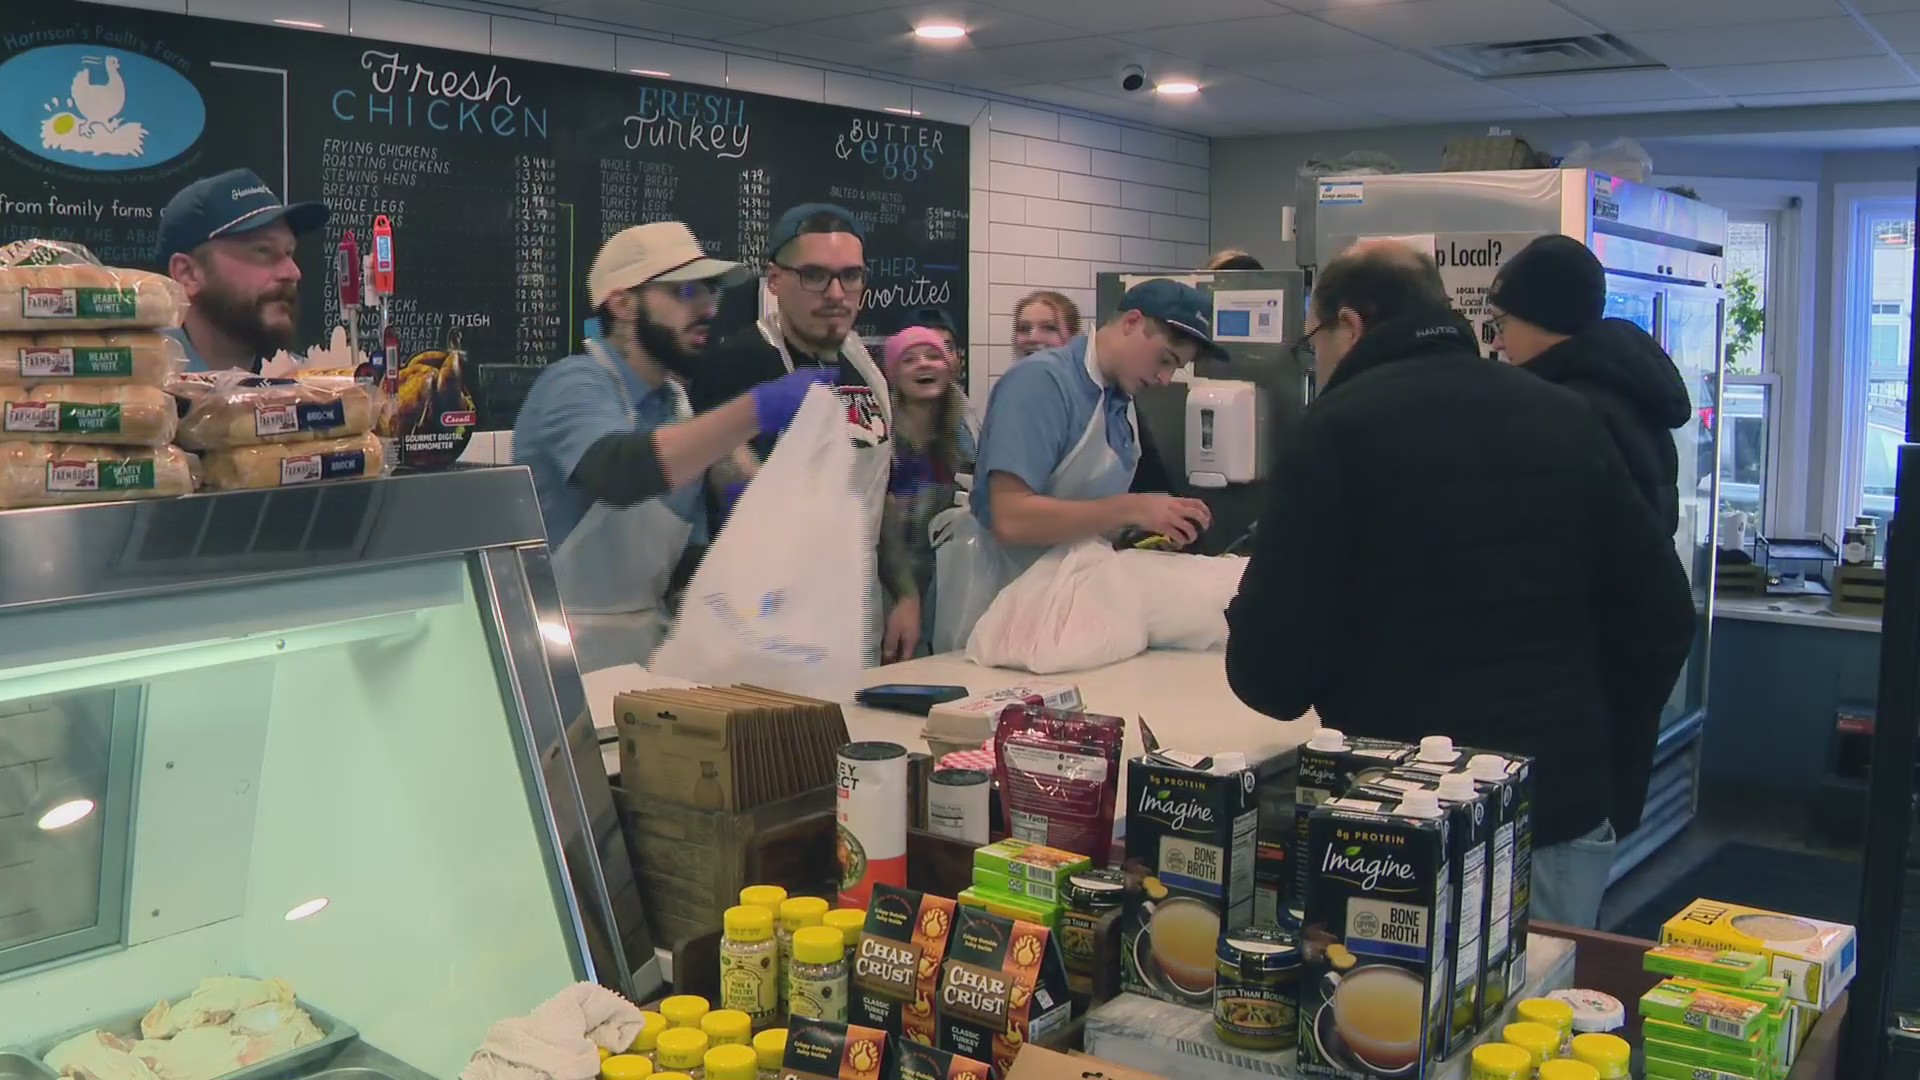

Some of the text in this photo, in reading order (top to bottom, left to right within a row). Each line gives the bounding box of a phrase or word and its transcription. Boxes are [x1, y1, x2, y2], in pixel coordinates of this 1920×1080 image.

[95, 25, 148, 50] Poultry
[153, 40, 192, 72] Farm
[361, 50, 521, 106] Fresh
[638, 87, 745, 128] FRESH
[624, 110, 750, 159] Turkey
[850, 118, 944, 154] BUTTER
[323, 138, 438, 159] FRYING CHICKENS
[322, 153, 450, 175] ROASTING CHICKENS
[835, 133, 935, 182] & eggs
[600, 158, 674, 175] WHOLE TURKEY
[322, 168, 417, 186] STEWING HENS
[601, 171, 679, 188] TURKEY BREAST
[322, 183, 379, 198] BREASTS
[601, 183, 675, 200] TURKEY WINGS
[0, 195, 154, 222] from family farms
[322, 197, 405, 213] WHOLE LEGS
[601, 196, 667, 211] TURKEY LEGS
[601, 209, 637, 222] TURKEY
[85, 227, 113, 242] THE
[1451, 238, 1503, 267] Local?
[449, 313, 491, 327] THIGH
[88, 352, 119, 362] HEARTY
[91, 361, 118, 371] WHITE
[76, 408, 107, 418] HEARTY
[78, 417, 105, 428] WHITE
[405, 433, 463, 443] GOURMET DIGITAL
[405, 442, 454, 451] THERMOMETER
[116, 474, 140, 485] WHITE
[1164, 776, 1206, 790] PROTEIN
[1336, 829, 1405, 845] 8g PROTEIN
[1194, 846, 1217, 866] BONE
[1187, 860, 1216, 881] BROTH
[1072, 919, 1090, 928] THAN
[1390, 907, 1420, 927] BONE
[1381, 923, 1419, 944] BROTH
[862, 938, 914, 965] CHAR
[949, 965, 1006, 994] CHAR
[1239, 988, 1260, 999] THAN
[863, 997, 890, 1010] CLASSIC
[864, 1005, 889, 1017] TURKEY
[869, 1013, 884, 1023] RUB
[951, 1026, 980, 1041] CLASSIC
[952, 1034, 980, 1048] TURKEY
[958, 1043, 973, 1053] RUB
